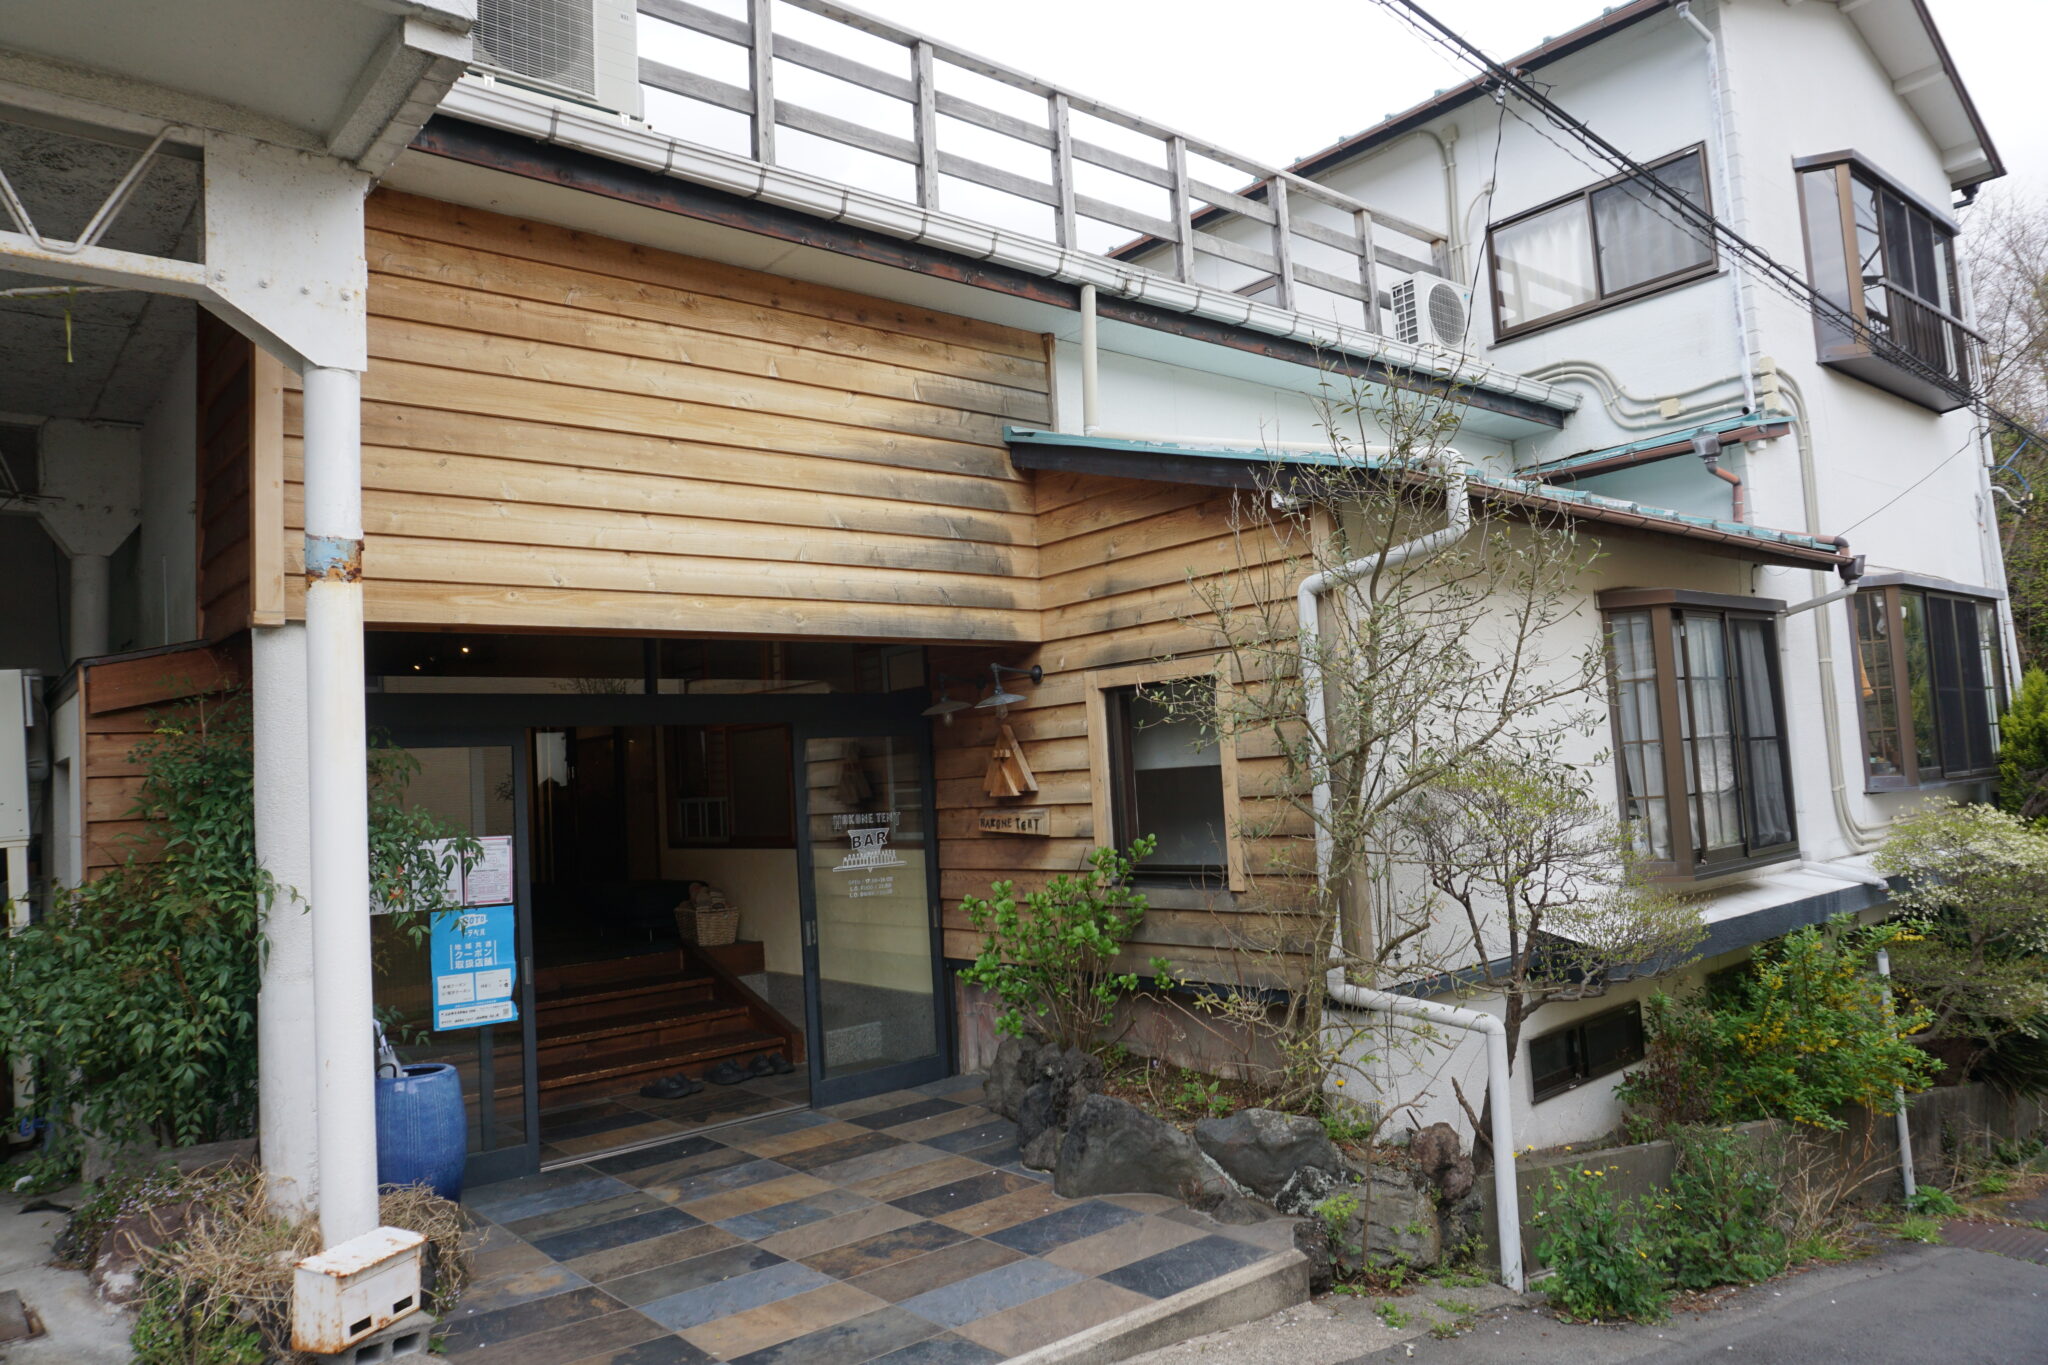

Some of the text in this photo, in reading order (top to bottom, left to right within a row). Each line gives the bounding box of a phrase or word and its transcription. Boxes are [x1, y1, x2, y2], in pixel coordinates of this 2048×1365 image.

[876, 811, 901, 826] TENT
[852, 831, 887, 849] BAR
[455, 948, 493, 960] クーポン
